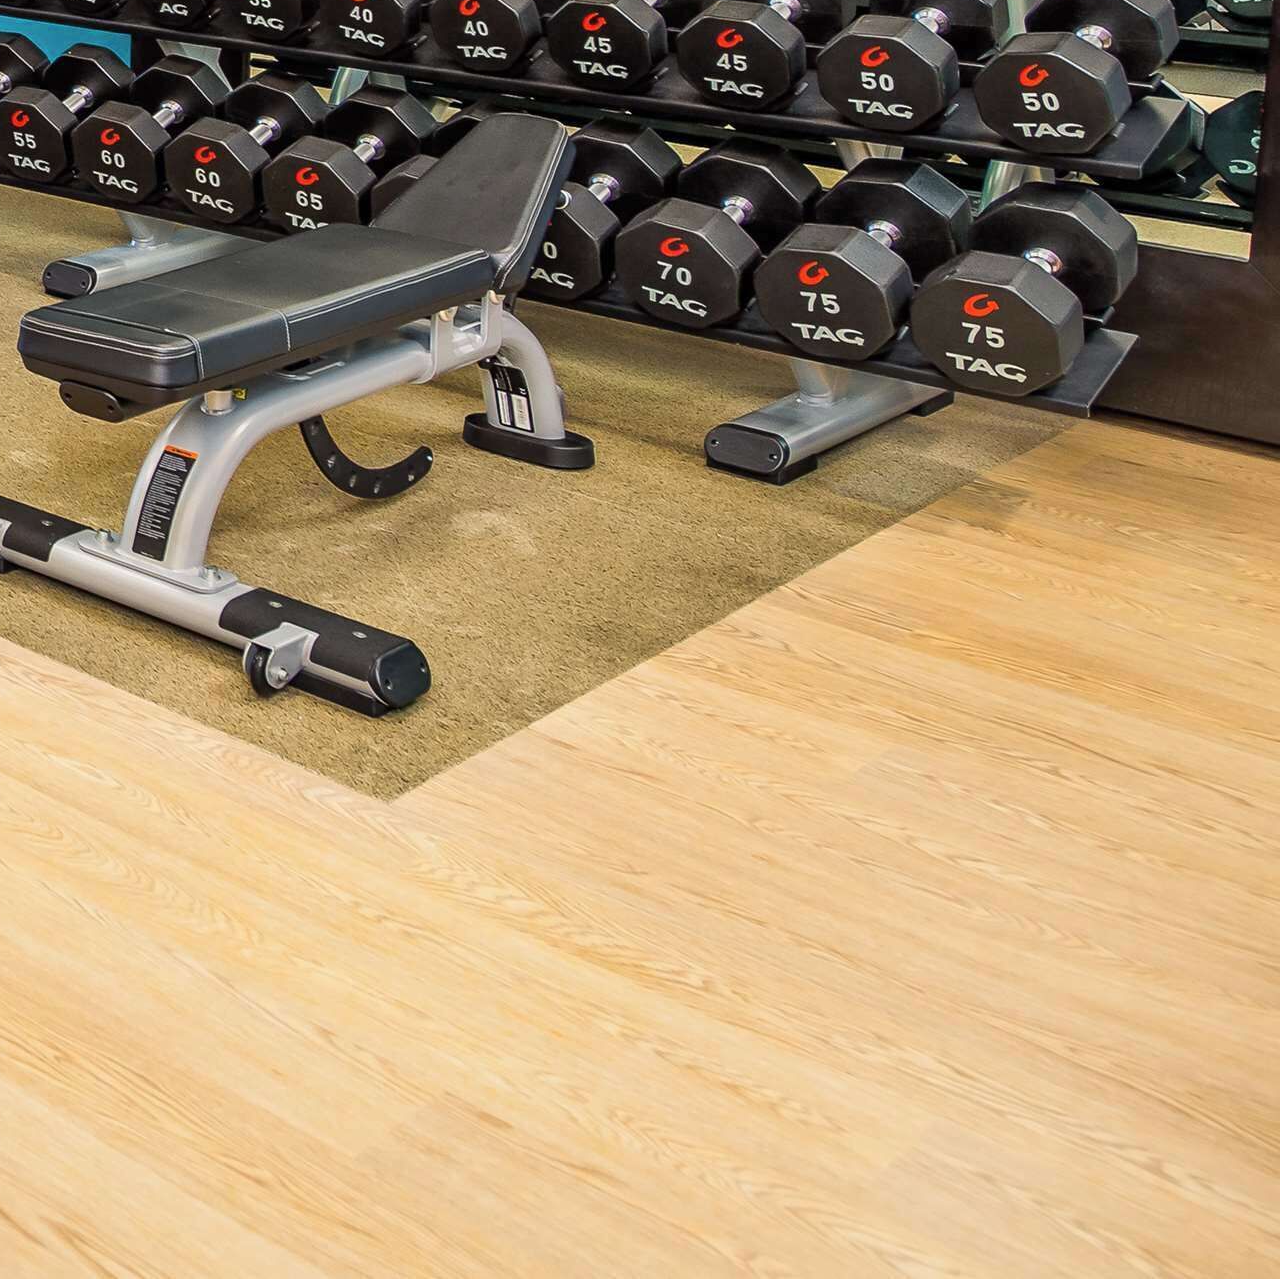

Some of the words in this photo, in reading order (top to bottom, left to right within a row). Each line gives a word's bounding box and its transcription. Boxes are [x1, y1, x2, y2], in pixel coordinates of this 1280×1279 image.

[241, 12, 284, 31] TAG
[350, 7, 373, 23] 40
[339, 25, 385, 47] TAG
[464, 21, 488, 36] 40
[457, 45, 507, 59] TAG
[583, 37, 611, 53] 45
[573, 60, 628, 78] TAG
[716, 53, 747, 71] 45
[704, 77, 764, 98] TAG
[861, 72, 894, 91] 50
[848, 99, 914, 119] TAG
[1021, 93, 1060, 112] 50
[1013, 122, 1086, 138] TAG
[13, 131, 36, 149] 55
[8, 154, 50, 173] TAG
[101, 150, 125, 169] 60
[93, 171, 138, 193] TAG
[195, 168, 220, 188] 60
[185, 189, 234, 214] TAG
[295, 190, 322, 210] 65
[543, 241, 559, 260] 0
[529, 267, 576, 289] AG
[656, 260, 693, 287] 70
[641, 285, 708, 318] TAG
[799, 291, 841, 314] 75
[791, 322, 864, 346] TAG
[962, 322, 1004, 349] 75
[946, 353, 1027, 383] TAG
